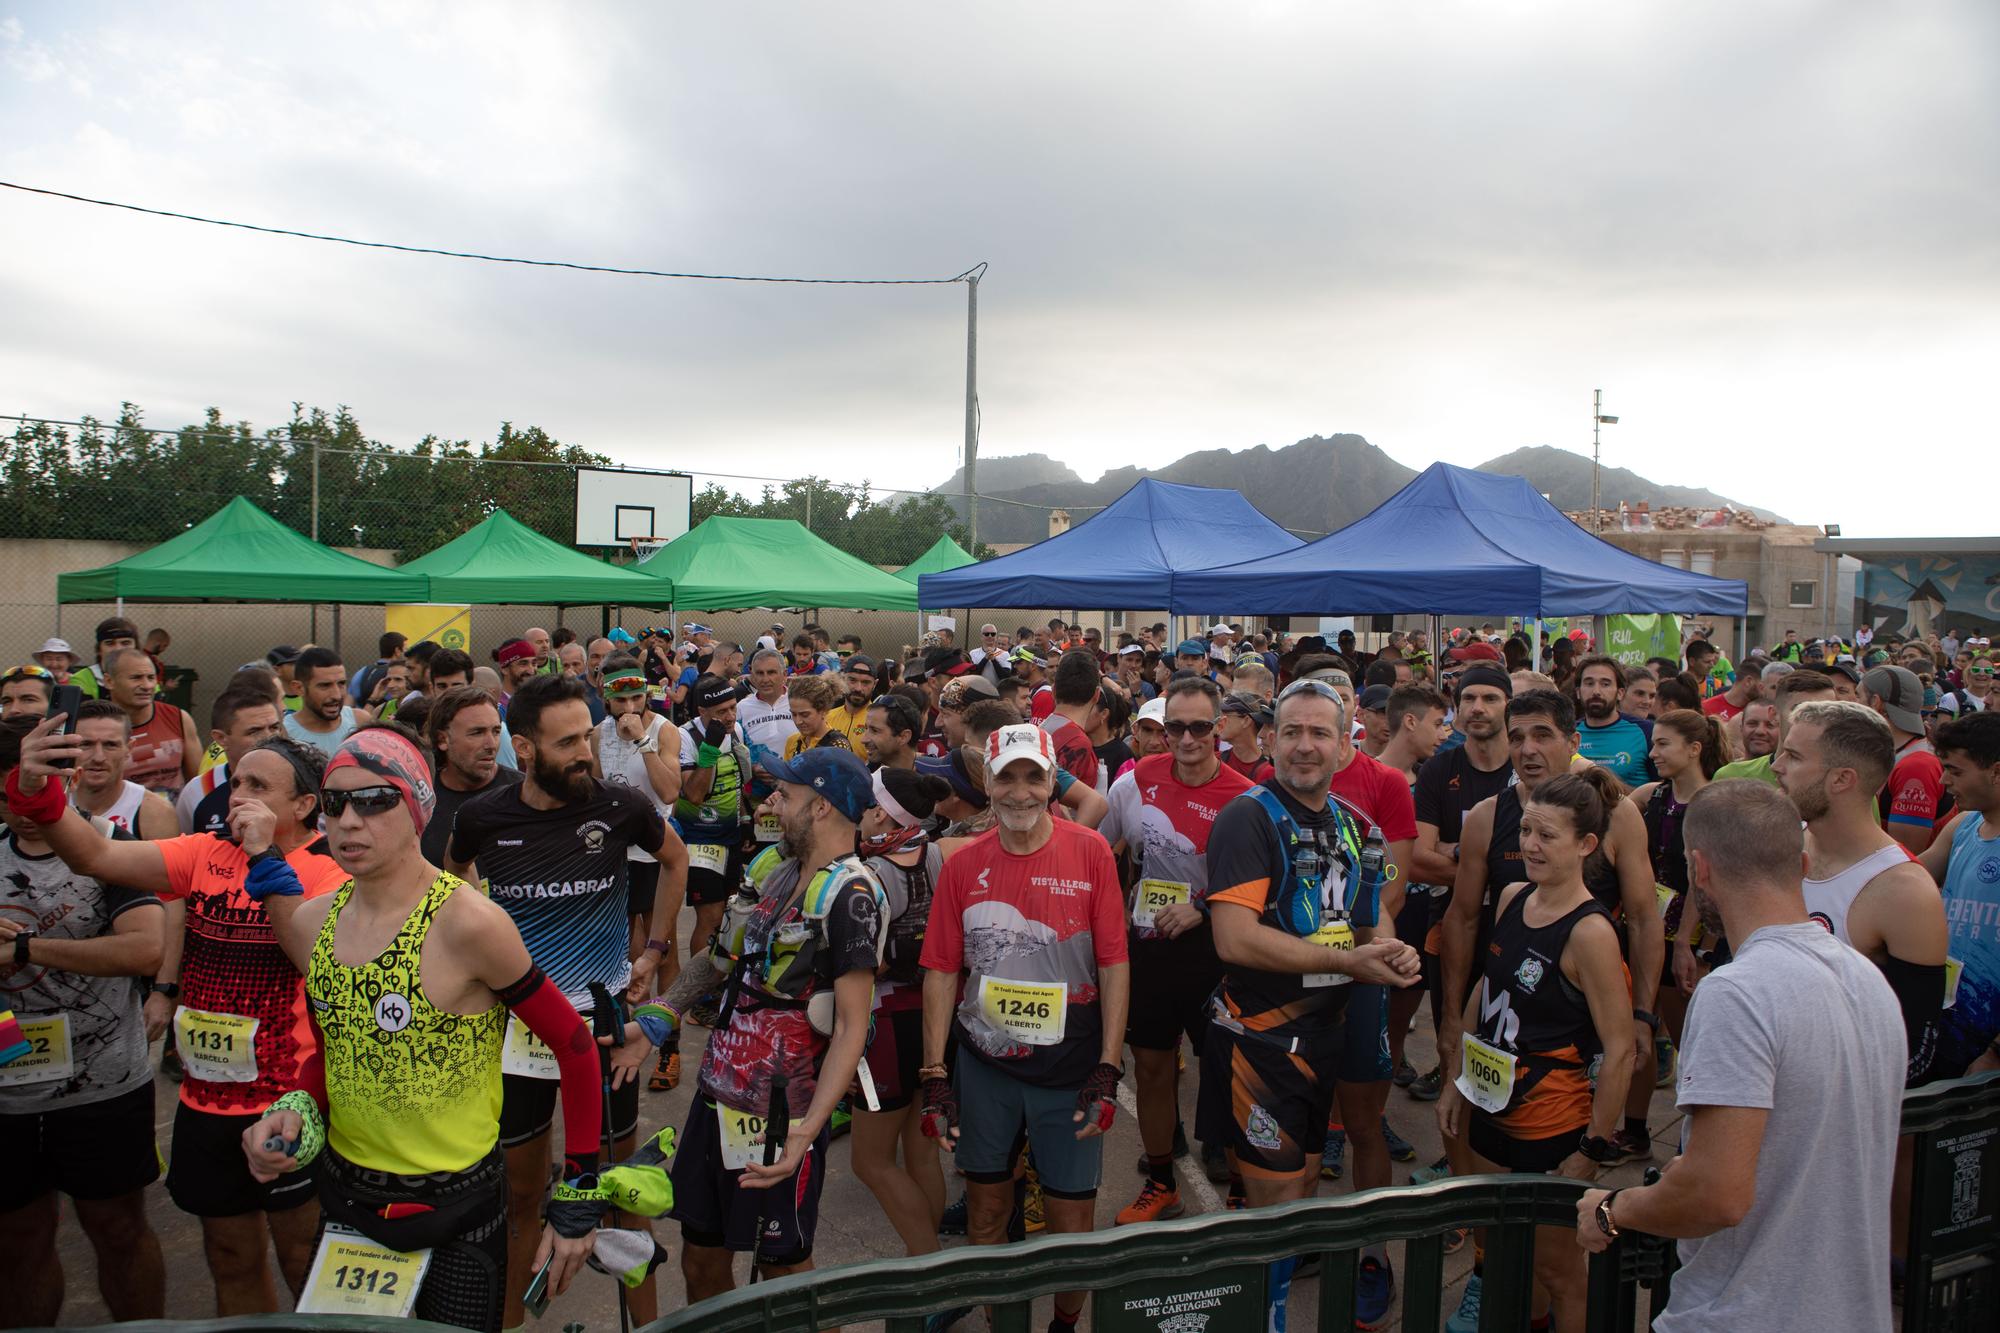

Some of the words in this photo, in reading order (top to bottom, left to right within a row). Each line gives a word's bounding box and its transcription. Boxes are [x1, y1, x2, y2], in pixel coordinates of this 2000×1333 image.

[1187, 800, 1208, 813] VISTA
[1895, 801, 1932, 814] QUIPAR
[697, 845, 720, 857] 1031
[1031, 876, 1058, 888] VISTA
[1050, 886, 1076, 897] TRAIL
[37, 902, 74, 933] AGUA
[382, 1003, 404, 1027] kb
[997, 998, 1050, 1019] 1246
[1005, 1019, 1042, 1030] ALBERTO
[187, 1028, 234, 1051] 1131
[194, 1052, 230, 1064] MARCELO
[1470, 1058, 1500, 1086] 1060
[358, 1250, 381, 1260] Sendero
[382, 1252, 391, 1261] del
[391, 1255, 409, 1264] Agua
[335, 1265, 399, 1297] 1312
[1124, 1297, 1162, 1311] EXCMO.
[1165, 1284, 1242, 1305] AYUNTAMIENTO
[1146, 1306, 1161, 1318] DE
[1162, 1297, 1222, 1315] CARTAGENA
